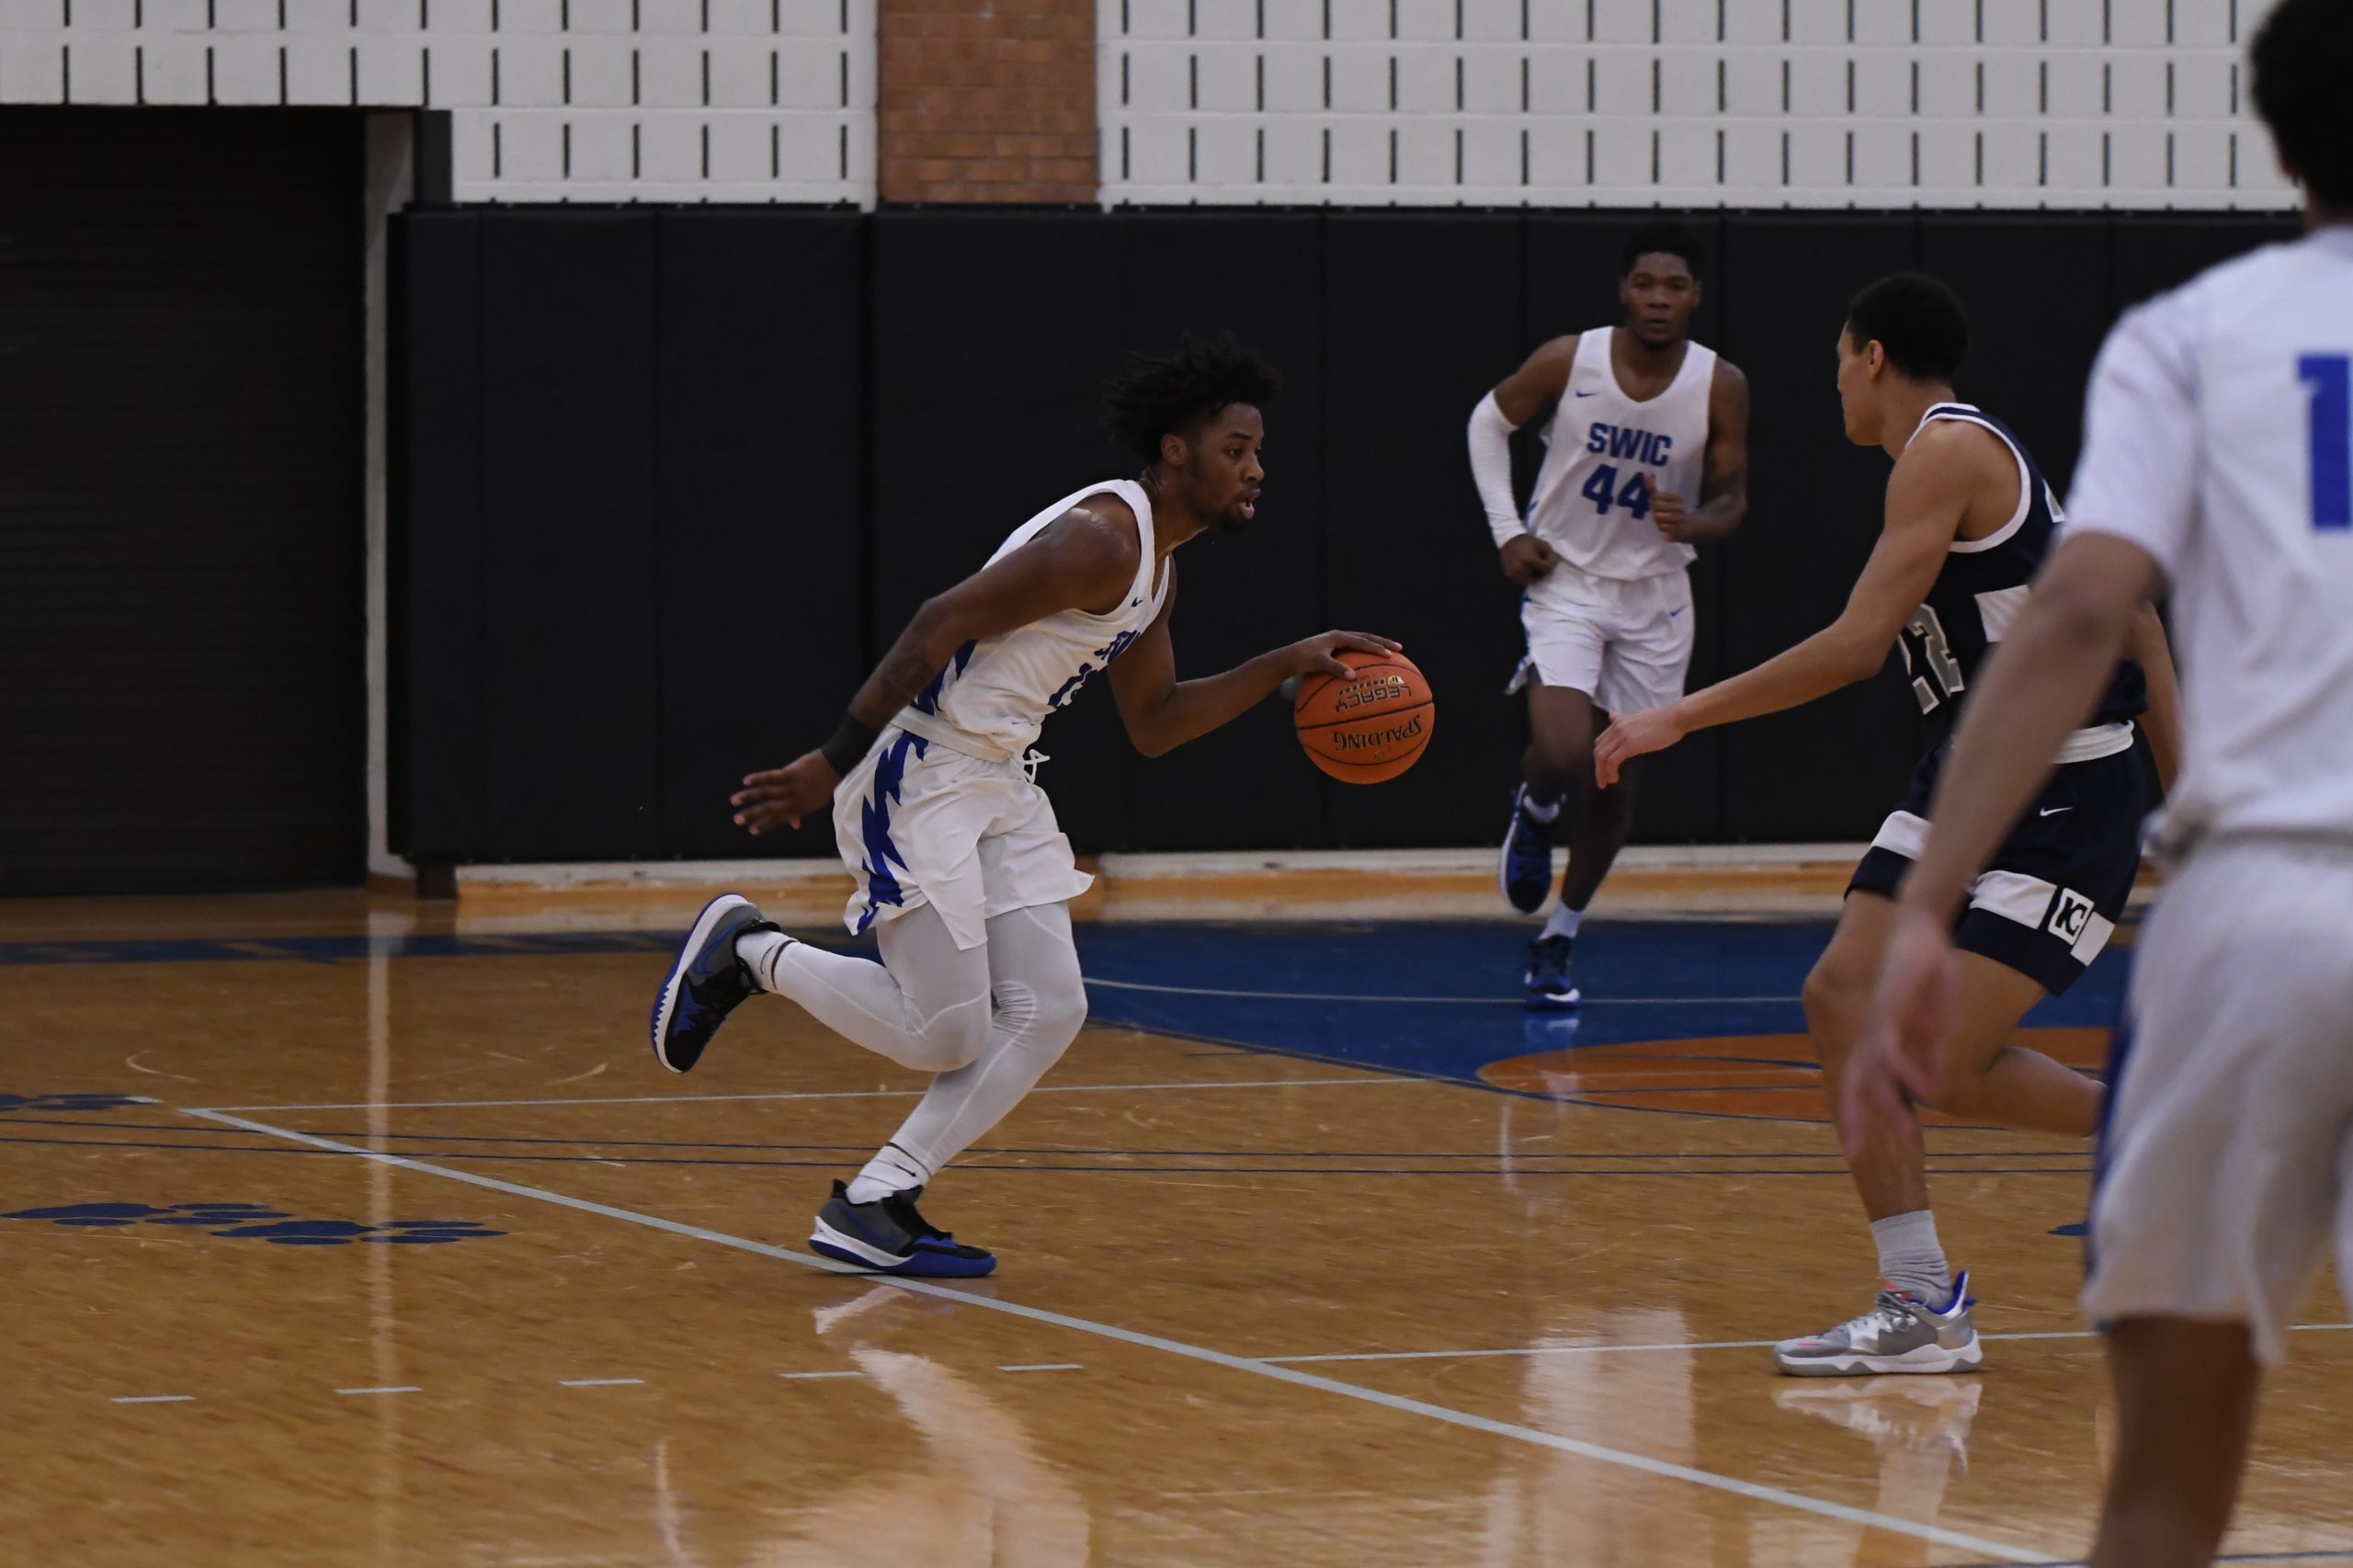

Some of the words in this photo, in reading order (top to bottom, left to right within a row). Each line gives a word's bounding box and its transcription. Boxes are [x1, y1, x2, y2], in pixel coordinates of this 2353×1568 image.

[1586, 422, 1672, 466] SWIC
[1581, 463, 1655, 520] 44
[1336, 685, 1412, 713] LEGACY
[1333, 714, 1422, 750] SPALDING
